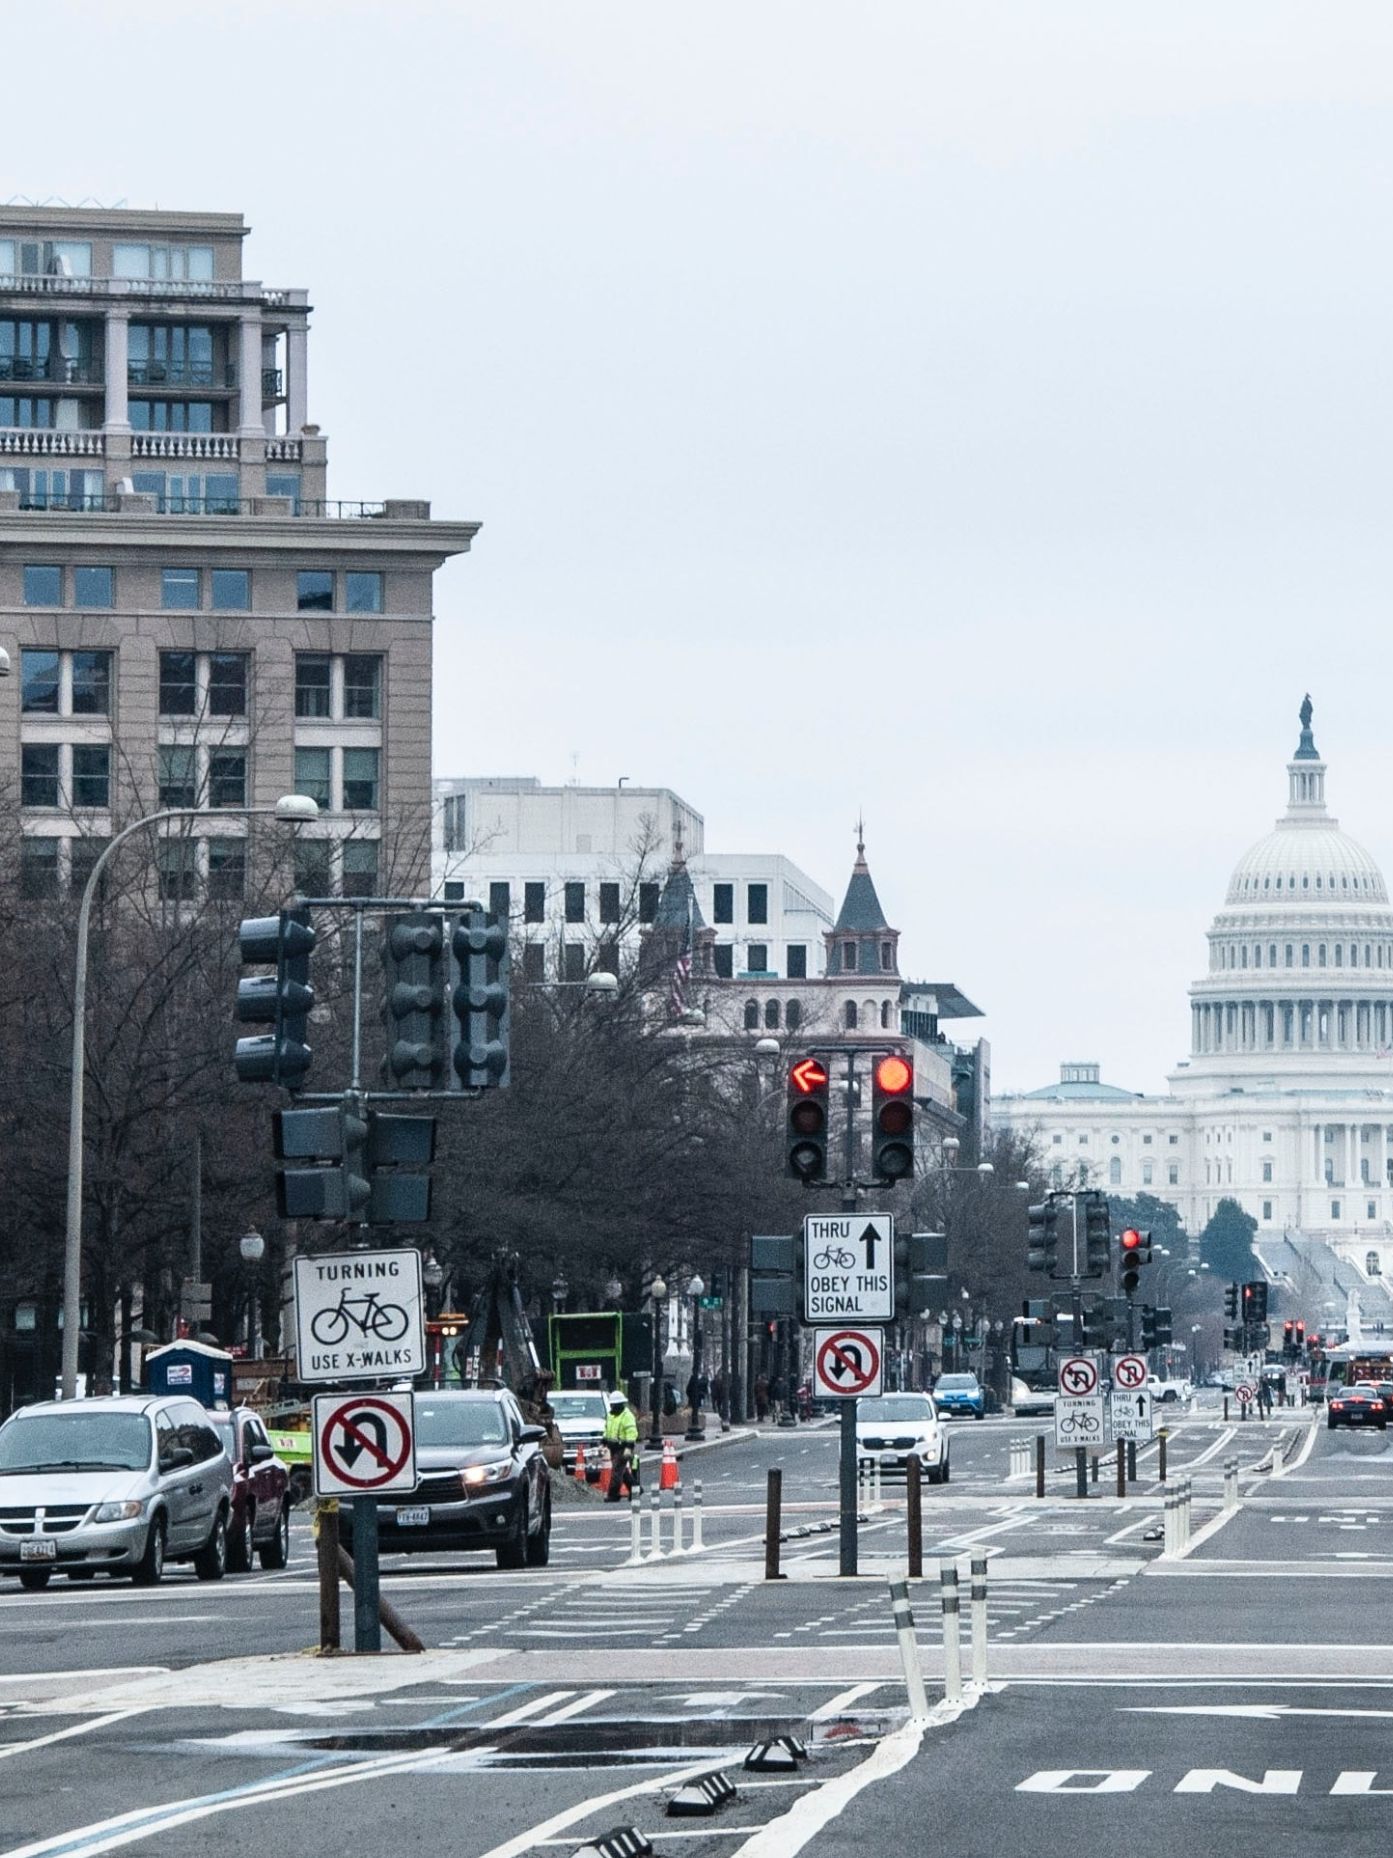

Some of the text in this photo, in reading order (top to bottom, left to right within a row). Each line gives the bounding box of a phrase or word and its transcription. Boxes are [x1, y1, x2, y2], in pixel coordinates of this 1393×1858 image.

[811, 1222, 850, 1238] THRU
[316, 1261, 399, 1281] TURNING
[811, 1275, 888, 1293] OBEY THIS
[811, 1296, 863, 1313] SIGNAL
[311, 1349, 412, 1370] USE X-WALKS
[1113, 1394, 1132, 1402] THRU
